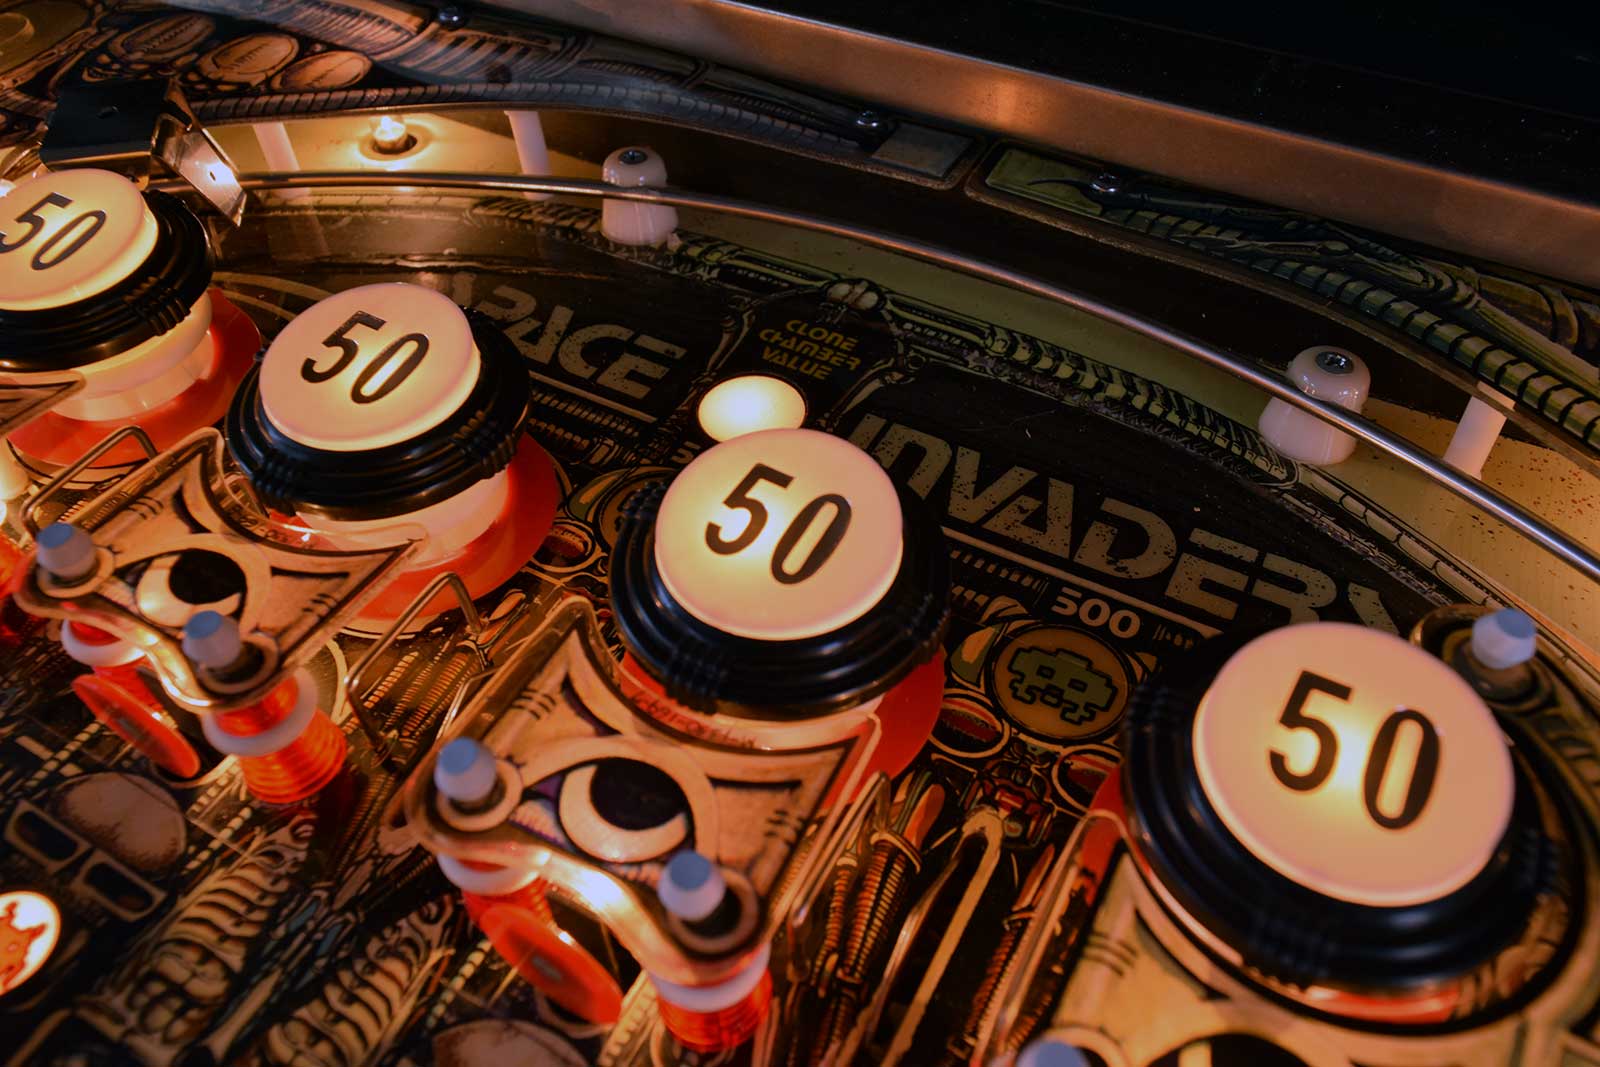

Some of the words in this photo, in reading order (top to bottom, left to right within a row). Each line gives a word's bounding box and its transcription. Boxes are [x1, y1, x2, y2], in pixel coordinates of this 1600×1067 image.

[0, 192, 107, 271] 50
[300, 311, 430, 404] 50
[761, 345, 833, 381] VALUE
[785, 320, 859, 352] CLONE
[705, 463, 852, 584] 50
[1052, 587, 1142, 639] 500
[1269, 670, 1441, 831] 50
